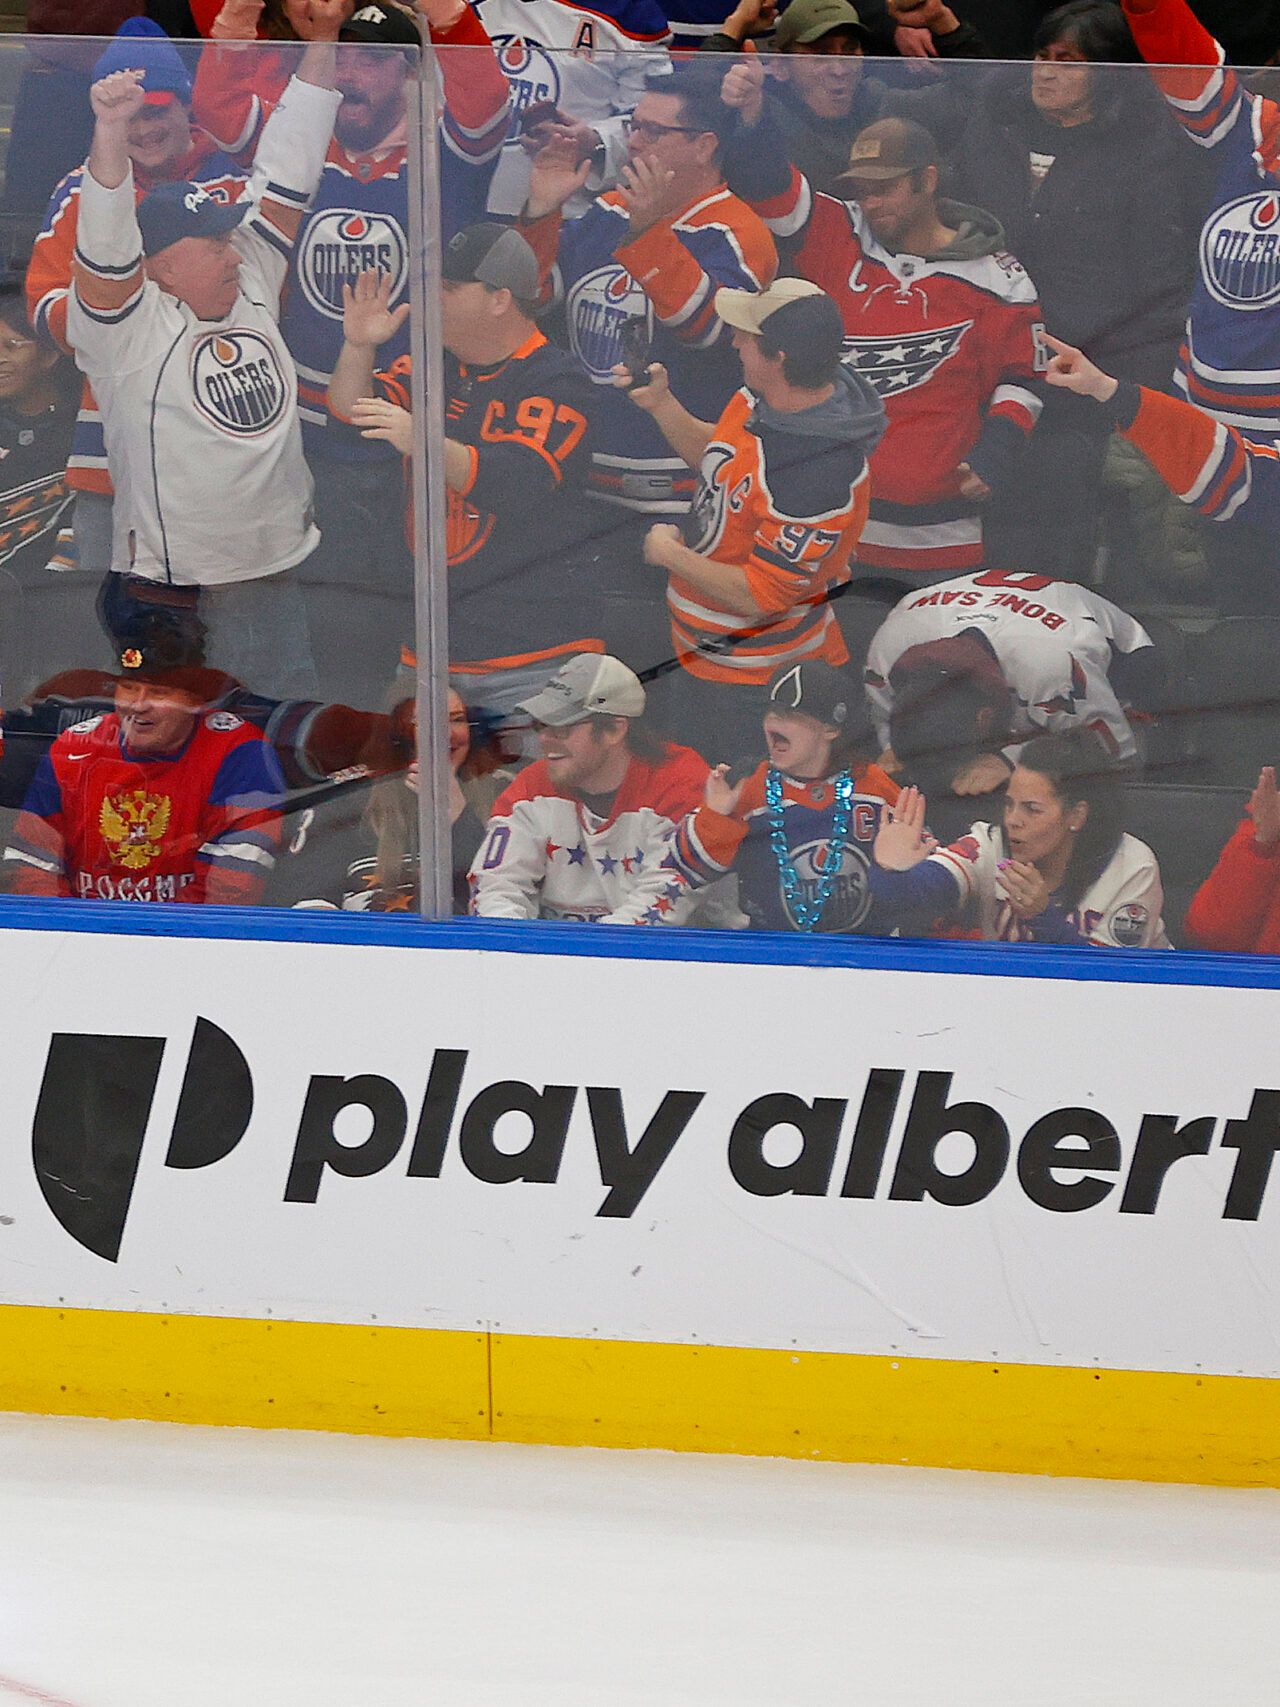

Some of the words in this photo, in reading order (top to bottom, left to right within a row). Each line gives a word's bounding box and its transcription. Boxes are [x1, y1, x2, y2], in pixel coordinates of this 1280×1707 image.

[571, 17, 598, 62] A
[205, 358, 277, 411] OILERS
[516, 396, 588, 462] 97
[907, 590, 984, 612] SAW
[983, 592, 1068, 631] BONE
[853, 803, 875, 842] C
[283, 1047, 706, 1220] play
